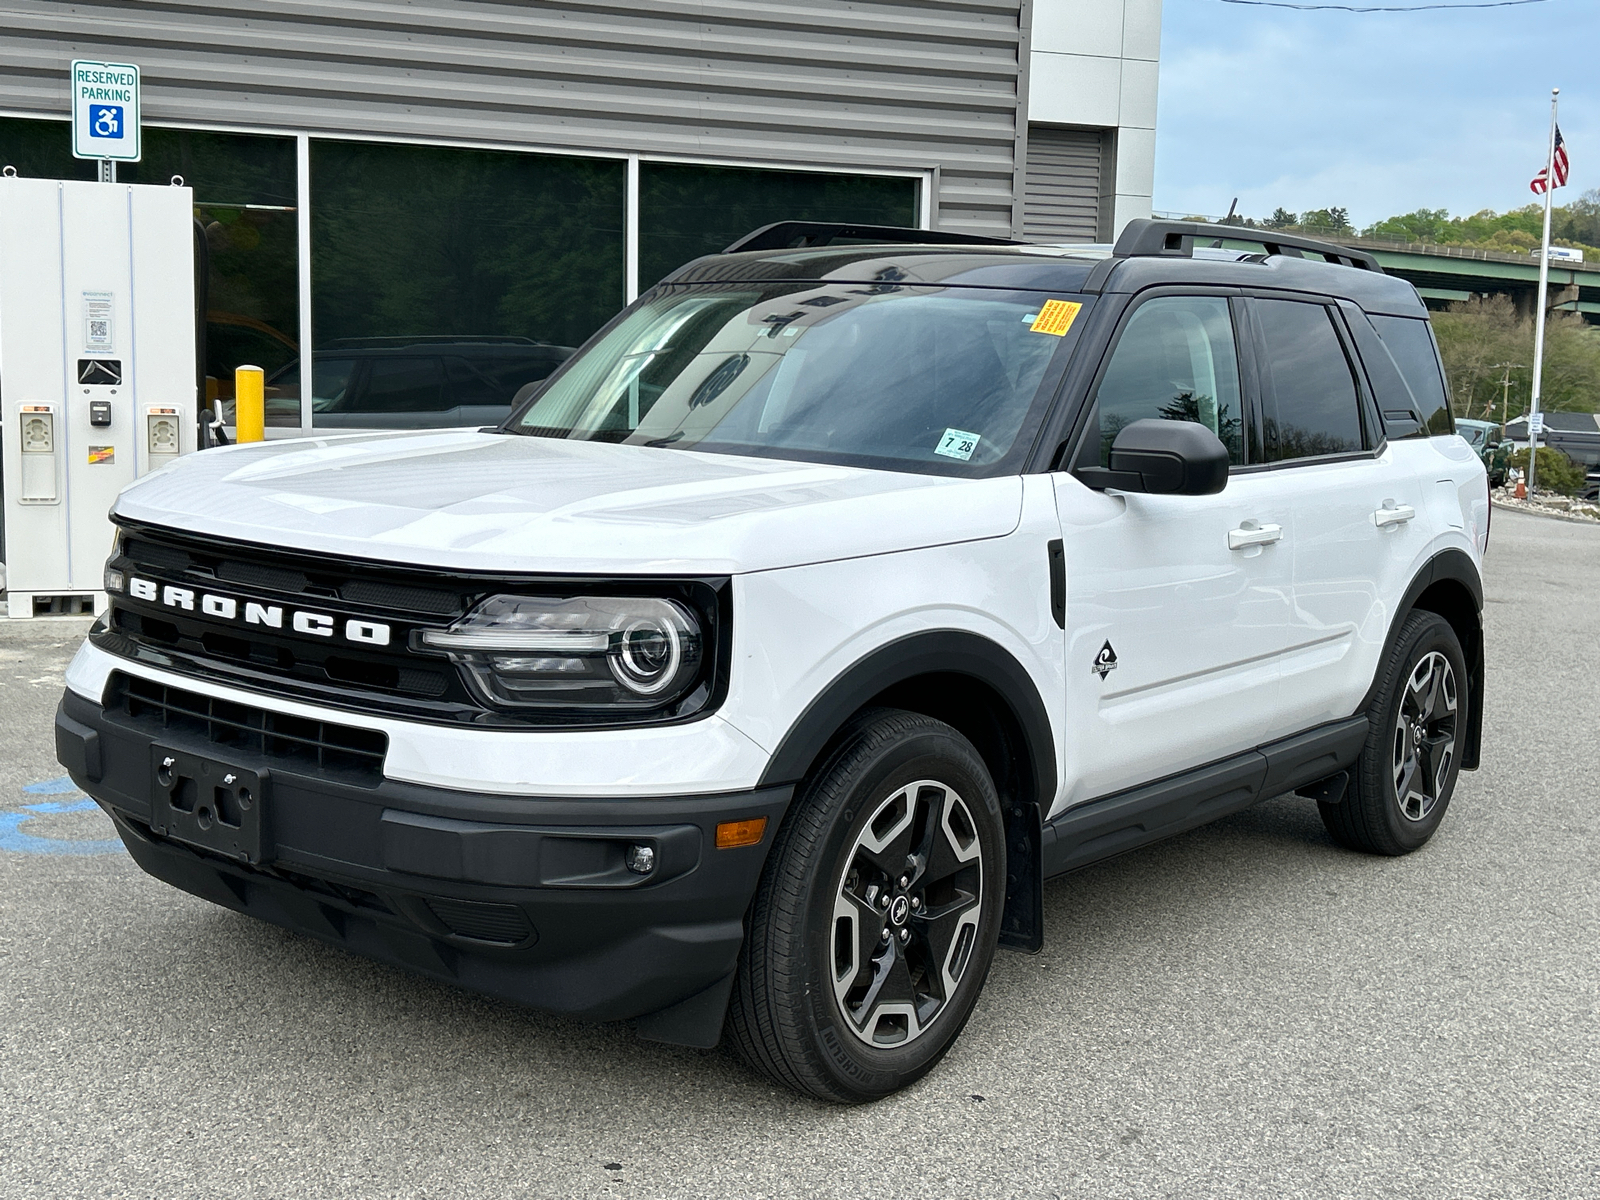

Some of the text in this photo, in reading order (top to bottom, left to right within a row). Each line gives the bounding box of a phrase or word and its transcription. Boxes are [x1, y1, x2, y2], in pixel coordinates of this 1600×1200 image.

[77, 69, 134, 86] RESERVED
[81, 86, 131, 102] PARKING
[945, 437, 973, 452] 7 28
[130, 577, 390, 646] BRONCO
[824, 1030, 875, 1083] MICHELIN
